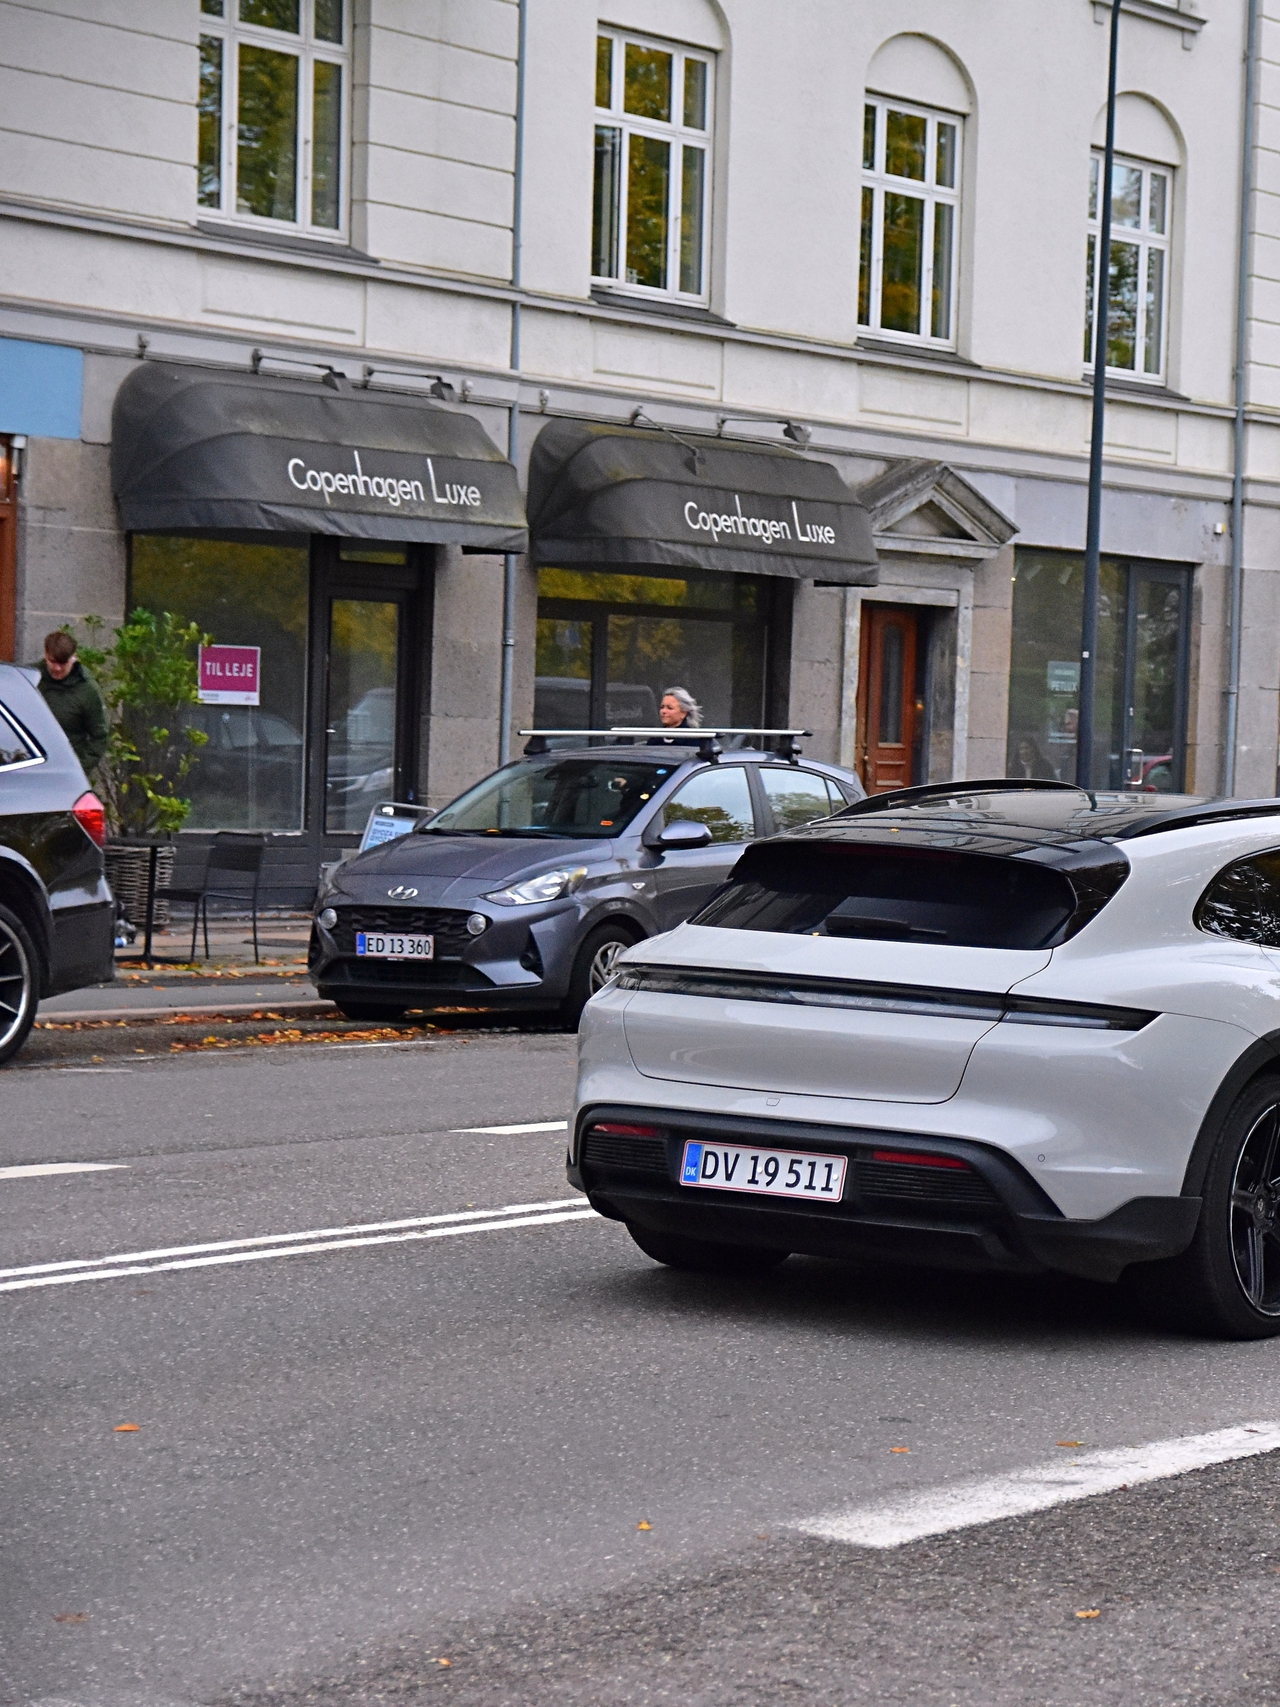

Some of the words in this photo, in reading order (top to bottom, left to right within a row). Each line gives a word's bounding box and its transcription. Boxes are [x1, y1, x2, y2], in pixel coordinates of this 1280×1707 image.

[287, 450, 425, 507] Copenhagen
[426, 457, 482, 507] Luxe
[684, 494, 792, 545] Copenhagen
[792, 500, 836, 545] Luxe
[205, 661, 223, 676] TIL
[225, 662, 254, 678] LEJE
[367, 937, 385, 953] ED
[389, 938, 405, 954] 13
[408, 939, 432, 955] 360
[685, 1166, 697, 1177] DK
[701, 1150, 741, 1182] DV
[747, 1154, 780, 1187] 19
[785, 1158, 834, 1193] 511
